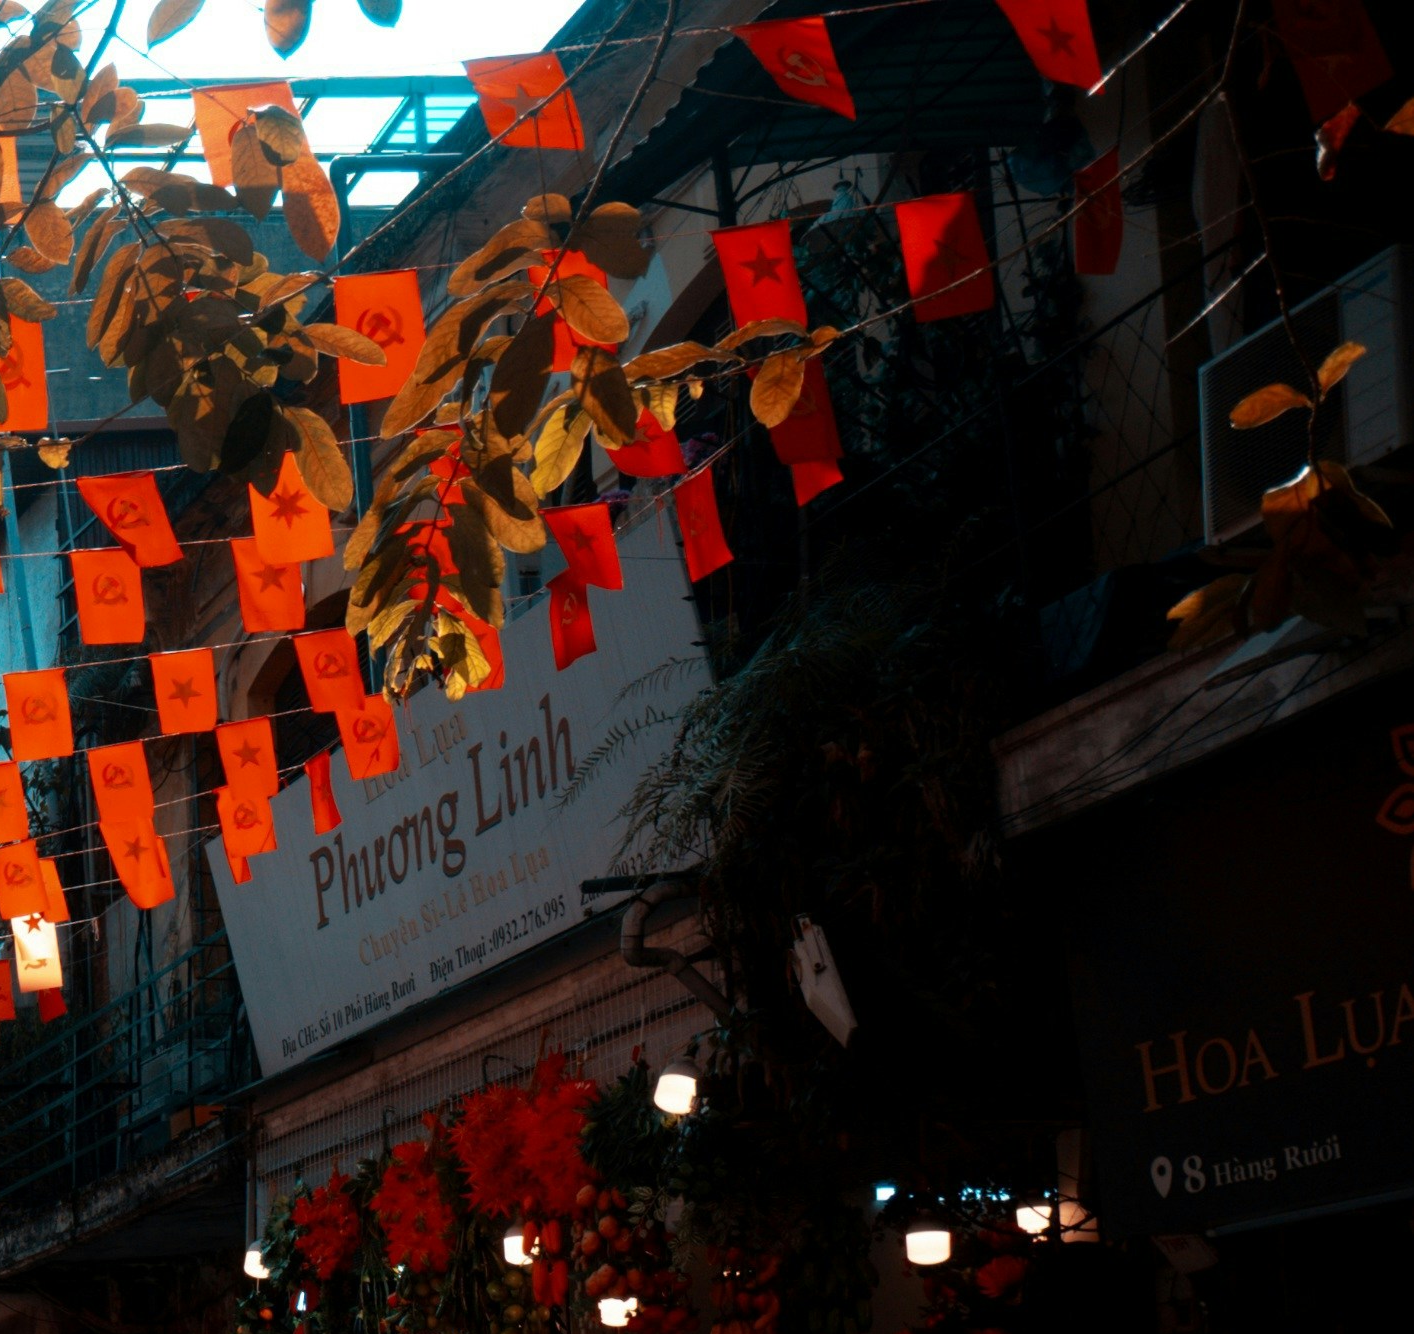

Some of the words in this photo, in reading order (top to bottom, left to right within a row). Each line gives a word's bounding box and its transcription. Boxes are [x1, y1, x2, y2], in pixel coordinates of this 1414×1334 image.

[309, 789, 467, 931] Phương
[467, 692, 576, 838] Linh
[359, 913, 421, 967] Chuyên
[469, 868, 509, 908] Hoa
[508, 846, 551, 885] Lụa
[319, 1009, 332, 1037] Số
[332, 1011, 344, 1032] 10
[344, 993, 364, 1026] Phố
[364, 991, 392, 1017] Hàng
[429, 955, 455, 983] Điện
[455, 935, 488, 965] Thoại
[1134, 1027, 1282, 1115] HOA
[1181, 1153, 1207, 1194] 8
[1212, 1155, 1279, 1188] Hàng
